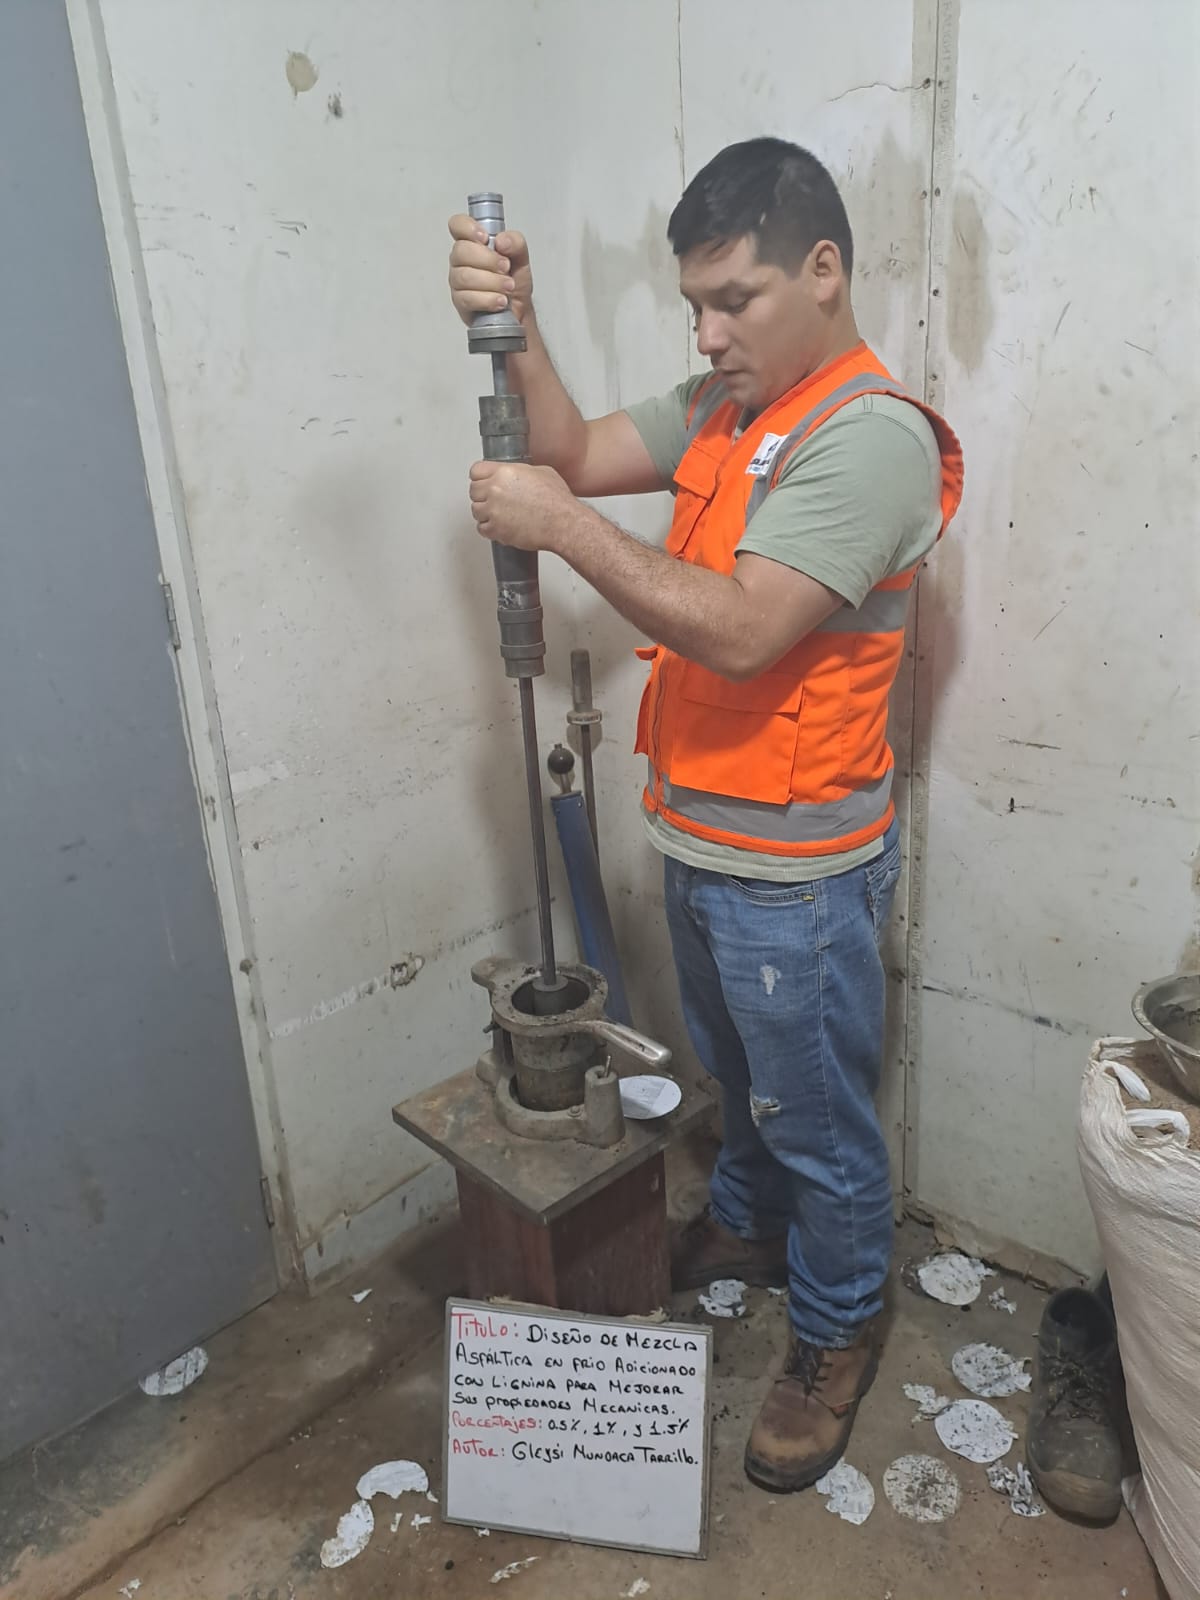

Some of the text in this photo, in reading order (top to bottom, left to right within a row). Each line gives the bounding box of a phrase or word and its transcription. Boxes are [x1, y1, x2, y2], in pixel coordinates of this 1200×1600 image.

[600, 1333, 618, 1347] DE
[626, 1332, 697, 1351] MEZCLA
[544, 1357, 563, 1367] EN
[454, 1374, 484, 1387] CON
[649, 1418, 690, 1436] 1.5%
